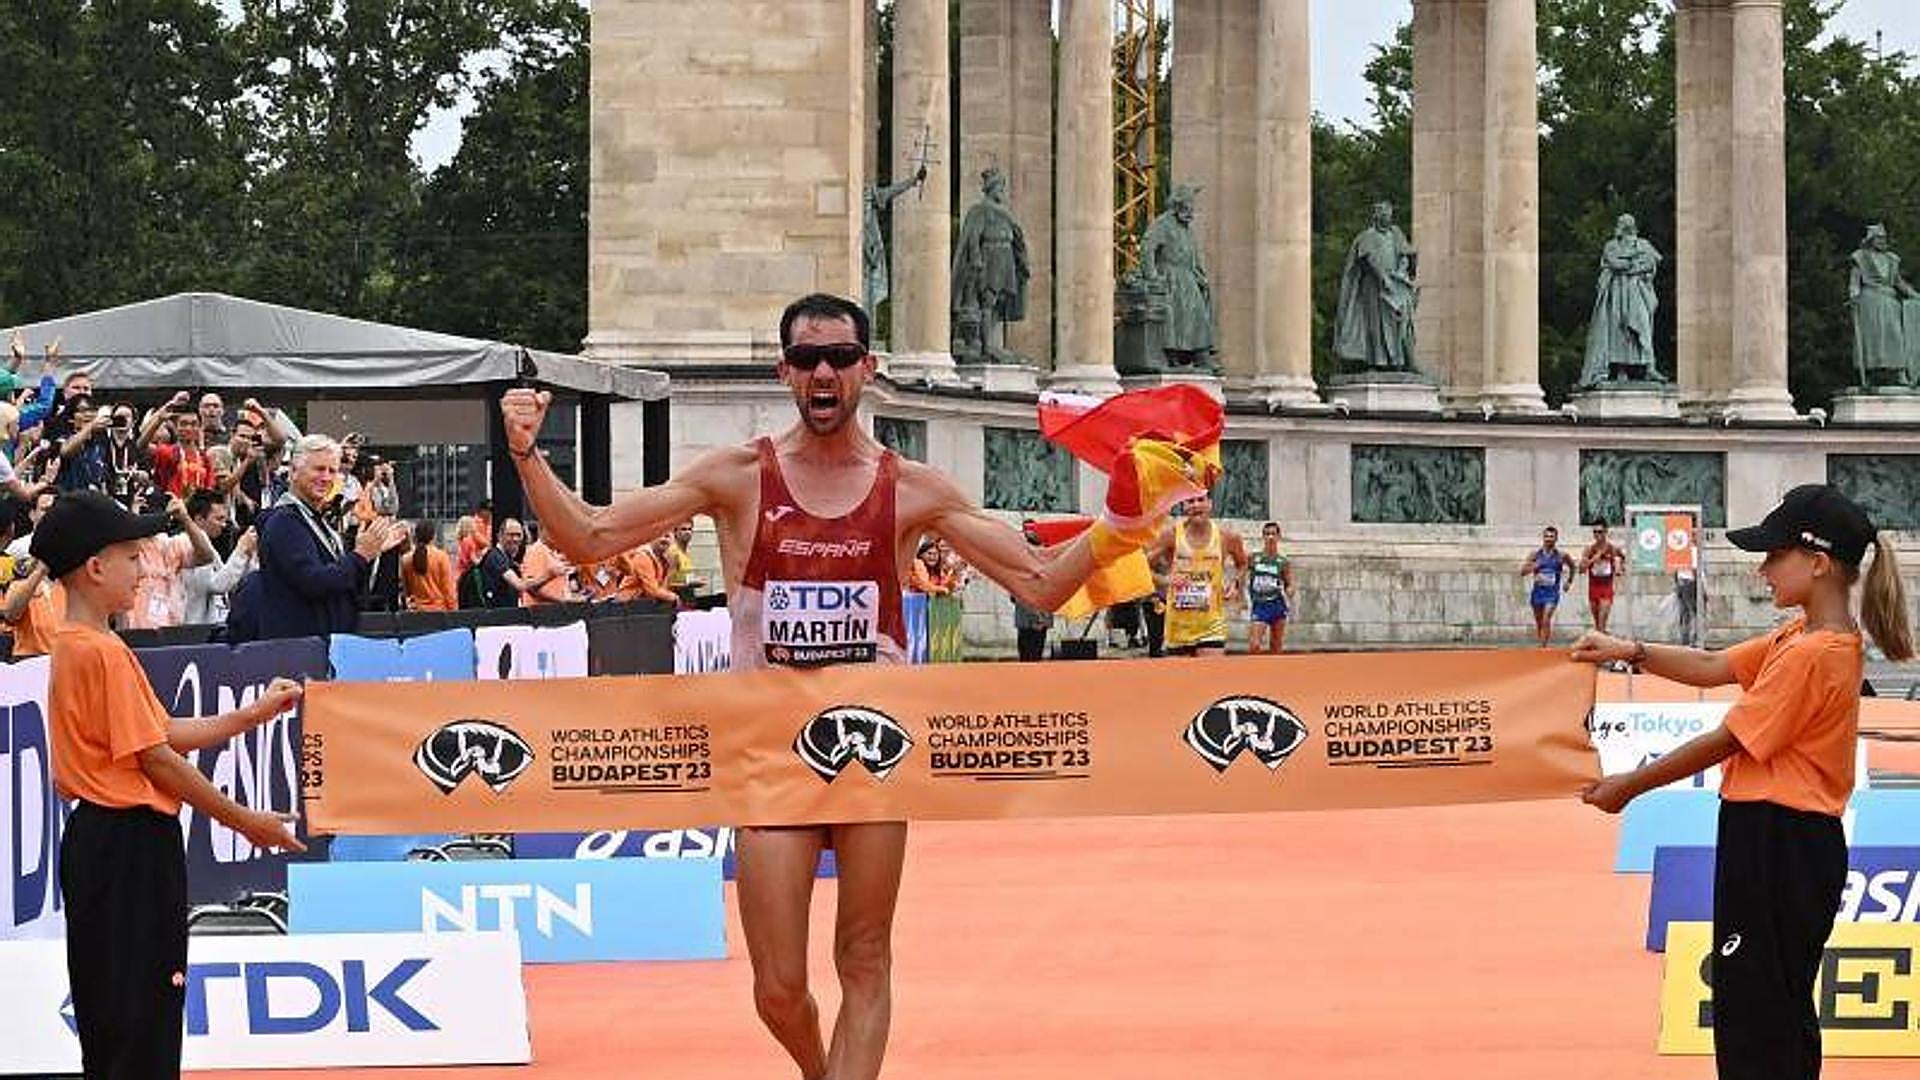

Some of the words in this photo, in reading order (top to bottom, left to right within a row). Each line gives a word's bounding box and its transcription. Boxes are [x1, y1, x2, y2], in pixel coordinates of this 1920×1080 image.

[776, 537, 872, 558] ESPAÑA
[790, 586, 868, 610] TDK
[769, 614, 869, 642] MARTÍN
[1324, 704, 1389, 719] WORLD
[1394, 700, 1491, 717] ATHLETICS
[927, 714, 988, 730] WORLD
[993, 712, 1088, 728] ATHLETICS
[1324, 717, 1491, 737] CHAMPIONSHIPS
[1629, 712, 1704, 737] Tokyo
[551, 728, 615, 743] WORLD
[620, 725, 709, 742] ATHLETICS
[928, 730, 1089, 749] CHAMPIONSHIPS
[550, 743, 710, 762] CHAMPIONSHIPS
[1327, 738, 1460, 758] BUDAPEST
[1464, 736, 1493, 751] 23
[930, 751, 1056, 769] BUDAPEST
[1062, 750, 1090, 766] 23
[552, 764, 682, 782] BUDAPEST
[686, 762, 711, 779] 23
[421, 882, 593, 940] NTN
[186, 958, 441, 1035] TDK
